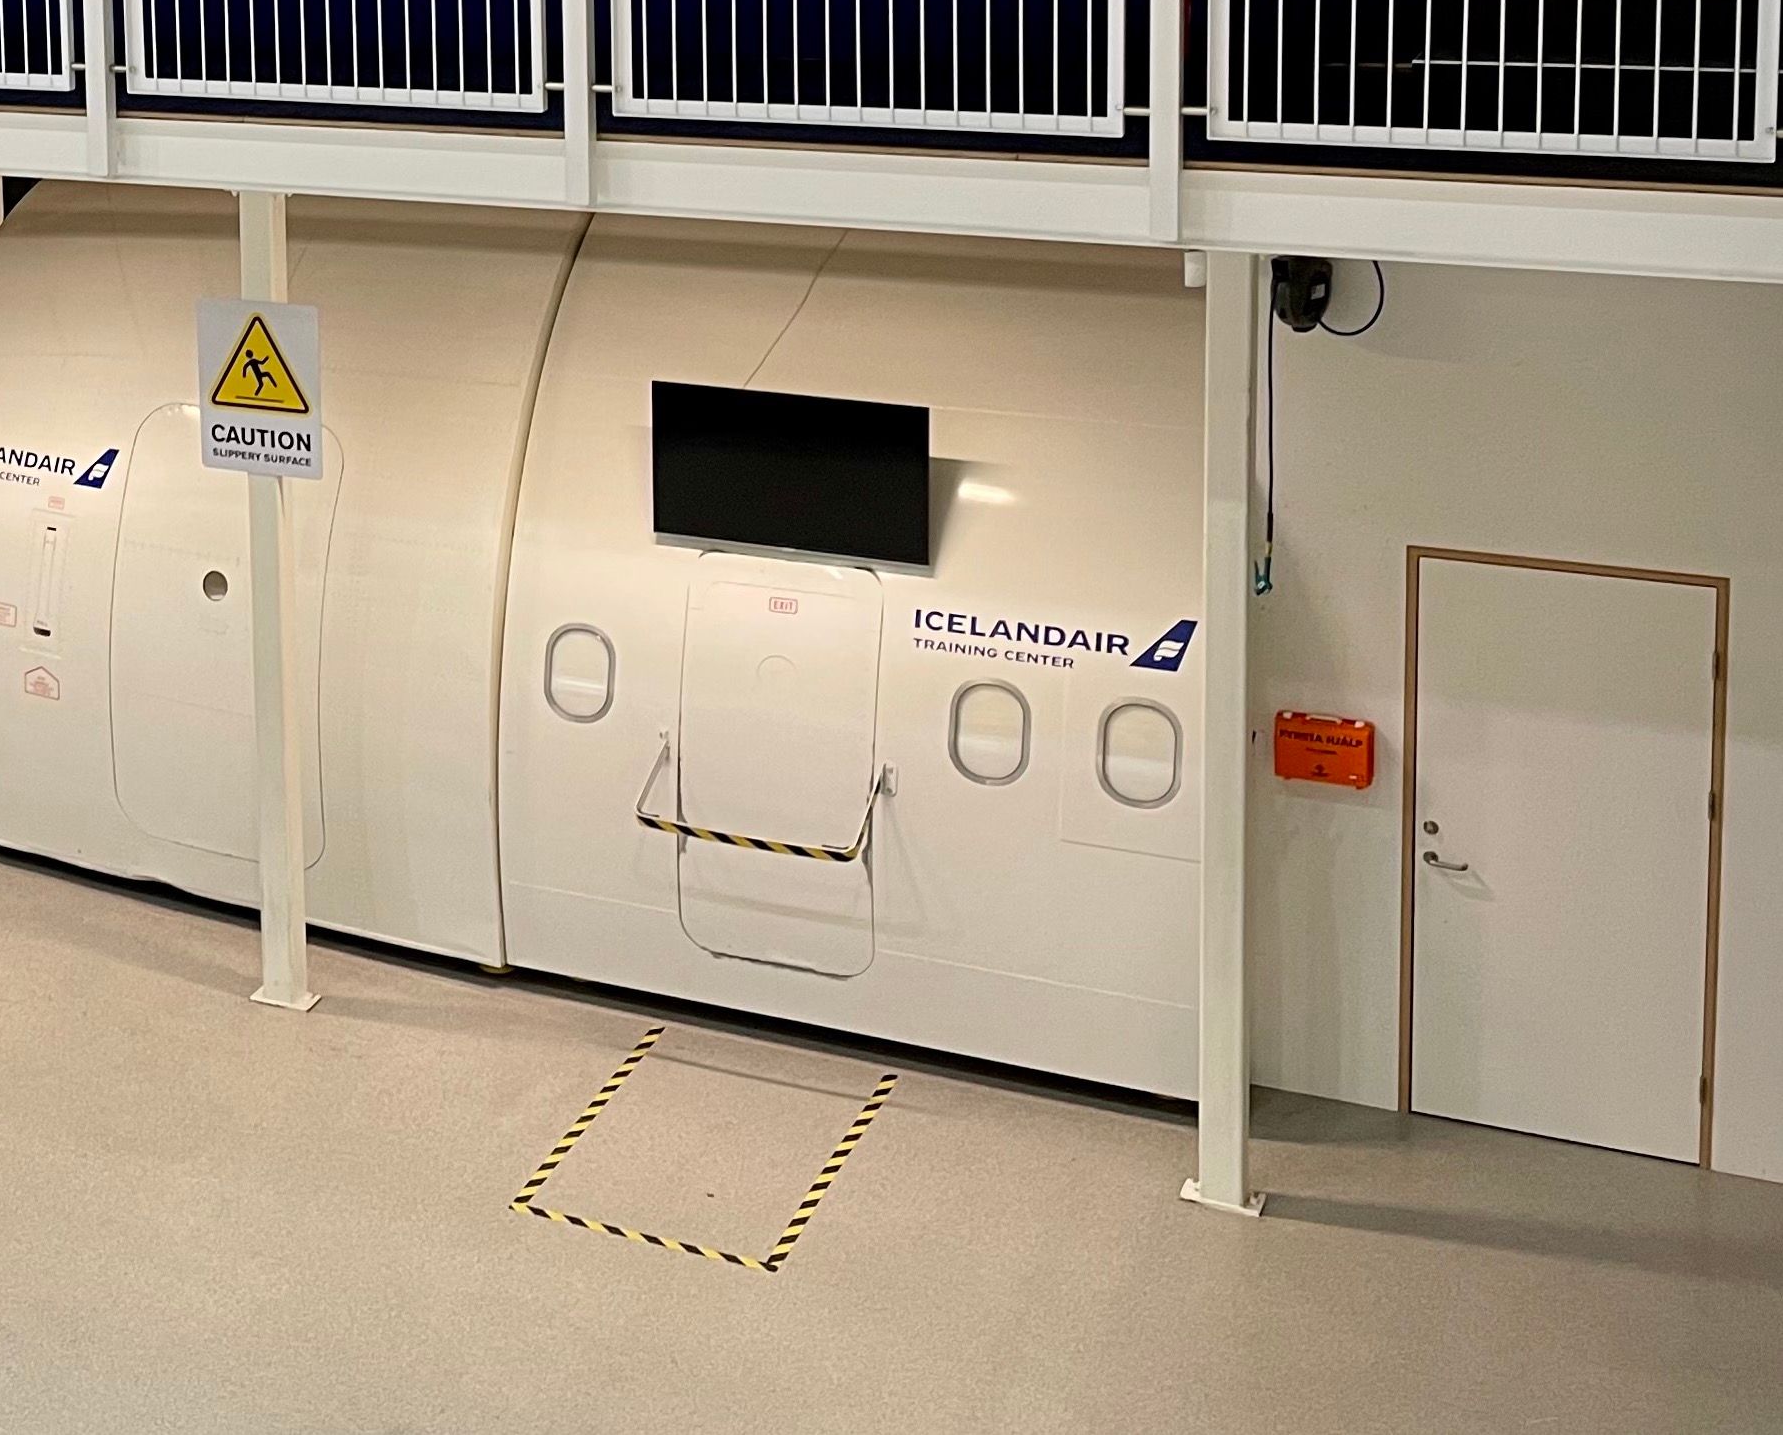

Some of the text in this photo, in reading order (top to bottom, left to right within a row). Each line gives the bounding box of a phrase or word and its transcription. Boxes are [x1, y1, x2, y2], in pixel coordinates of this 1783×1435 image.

[211, 424, 312, 452] CAUTION
[212, 447, 312, 467] SLIPPERY SURFACE
[0, 471, 41, 486] CENTER
[773, 600, 794, 611] EXIT
[914, 608, 1130, 656] ICELANDAIR
[913, 637, 1075, 669] TRAINING CENTER
